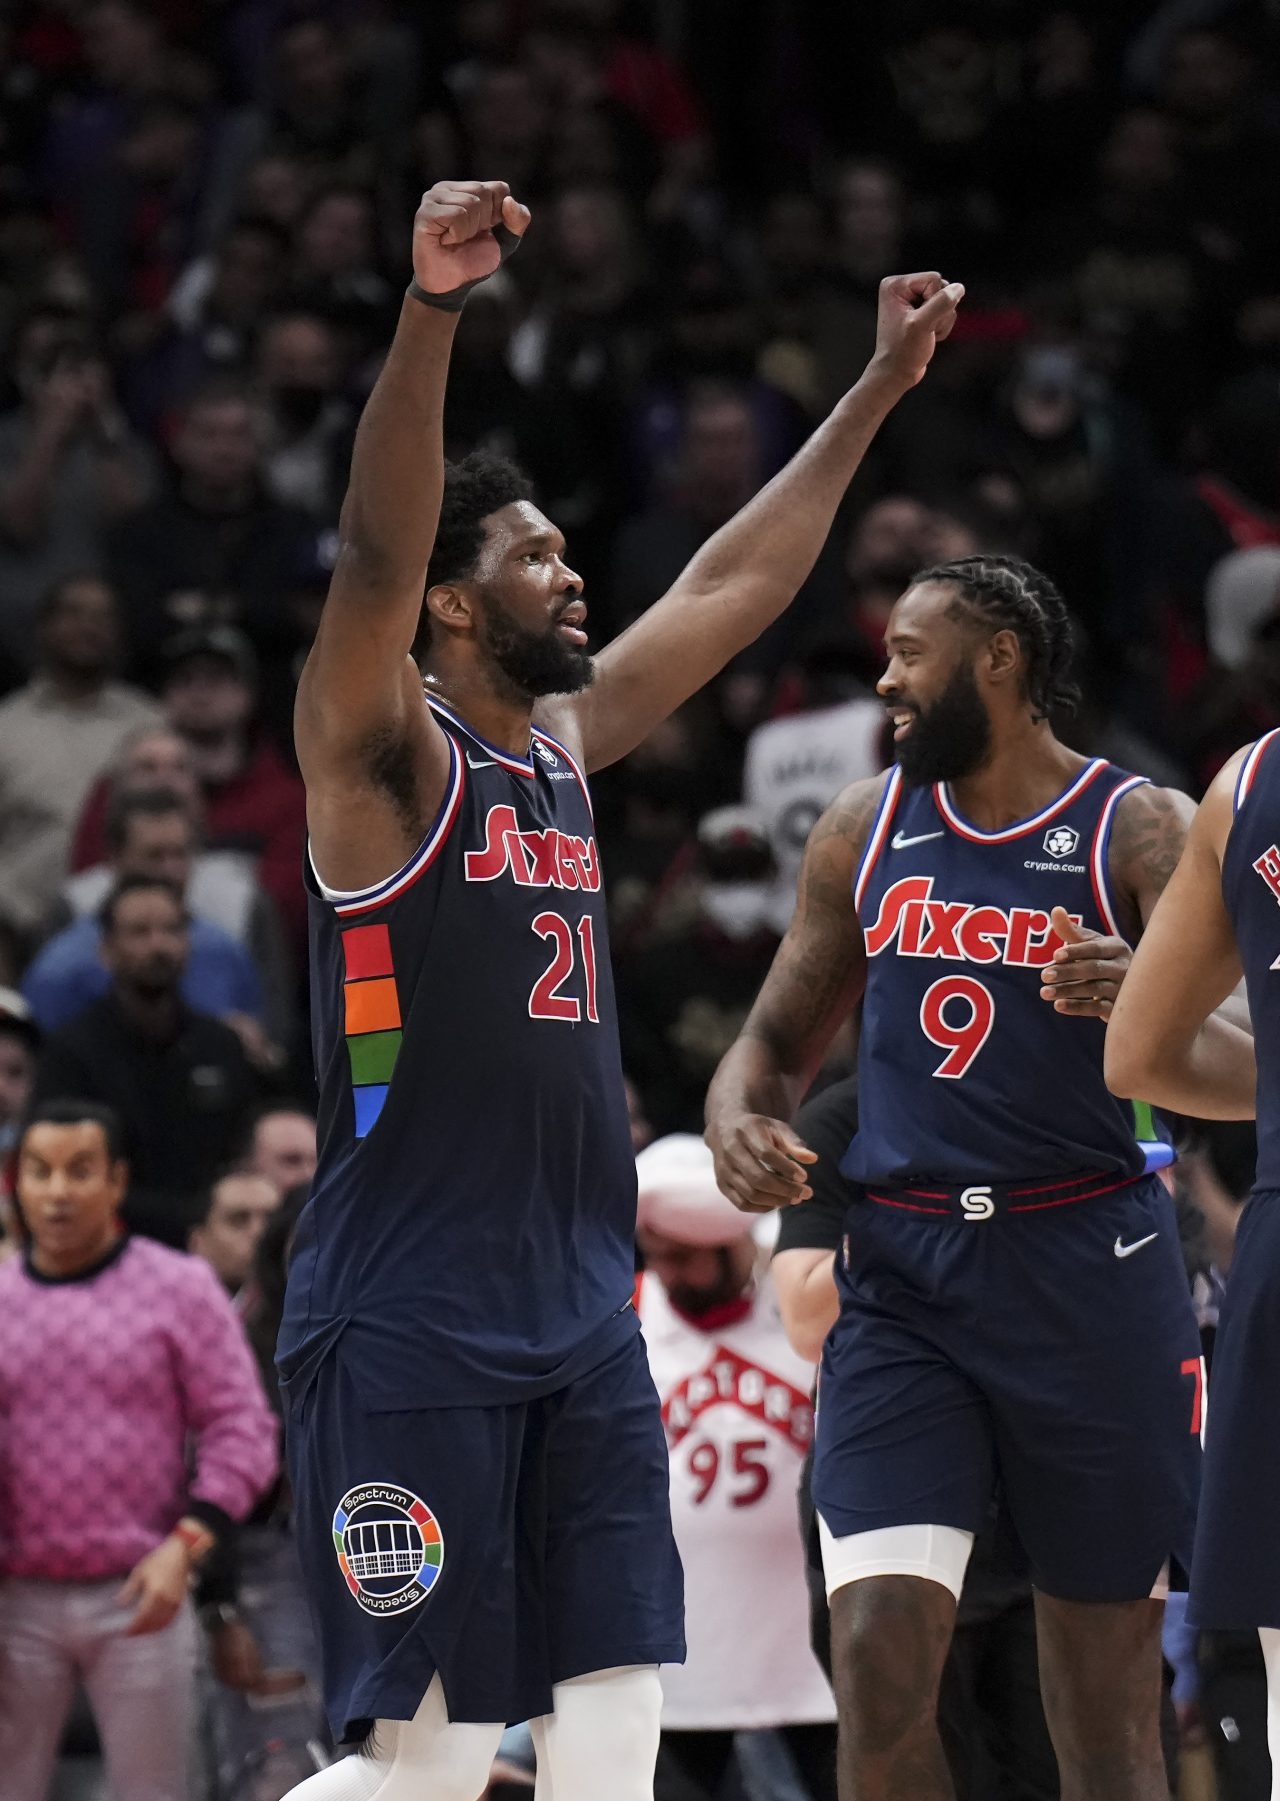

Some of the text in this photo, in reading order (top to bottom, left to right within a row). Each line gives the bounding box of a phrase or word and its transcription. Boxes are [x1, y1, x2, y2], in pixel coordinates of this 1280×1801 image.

[464, 804, 601, 892] Sixers
[1023, 860, 1086, 873] crypto.com
[528, 911, 600, 1024] 21
[919, 974, 995, 1079] 9
[344, 1488, 407, 1510] Spectrum
[688, 1439, 771, 1507] 95
[360, 1587, 420, 1611] Spectrum
